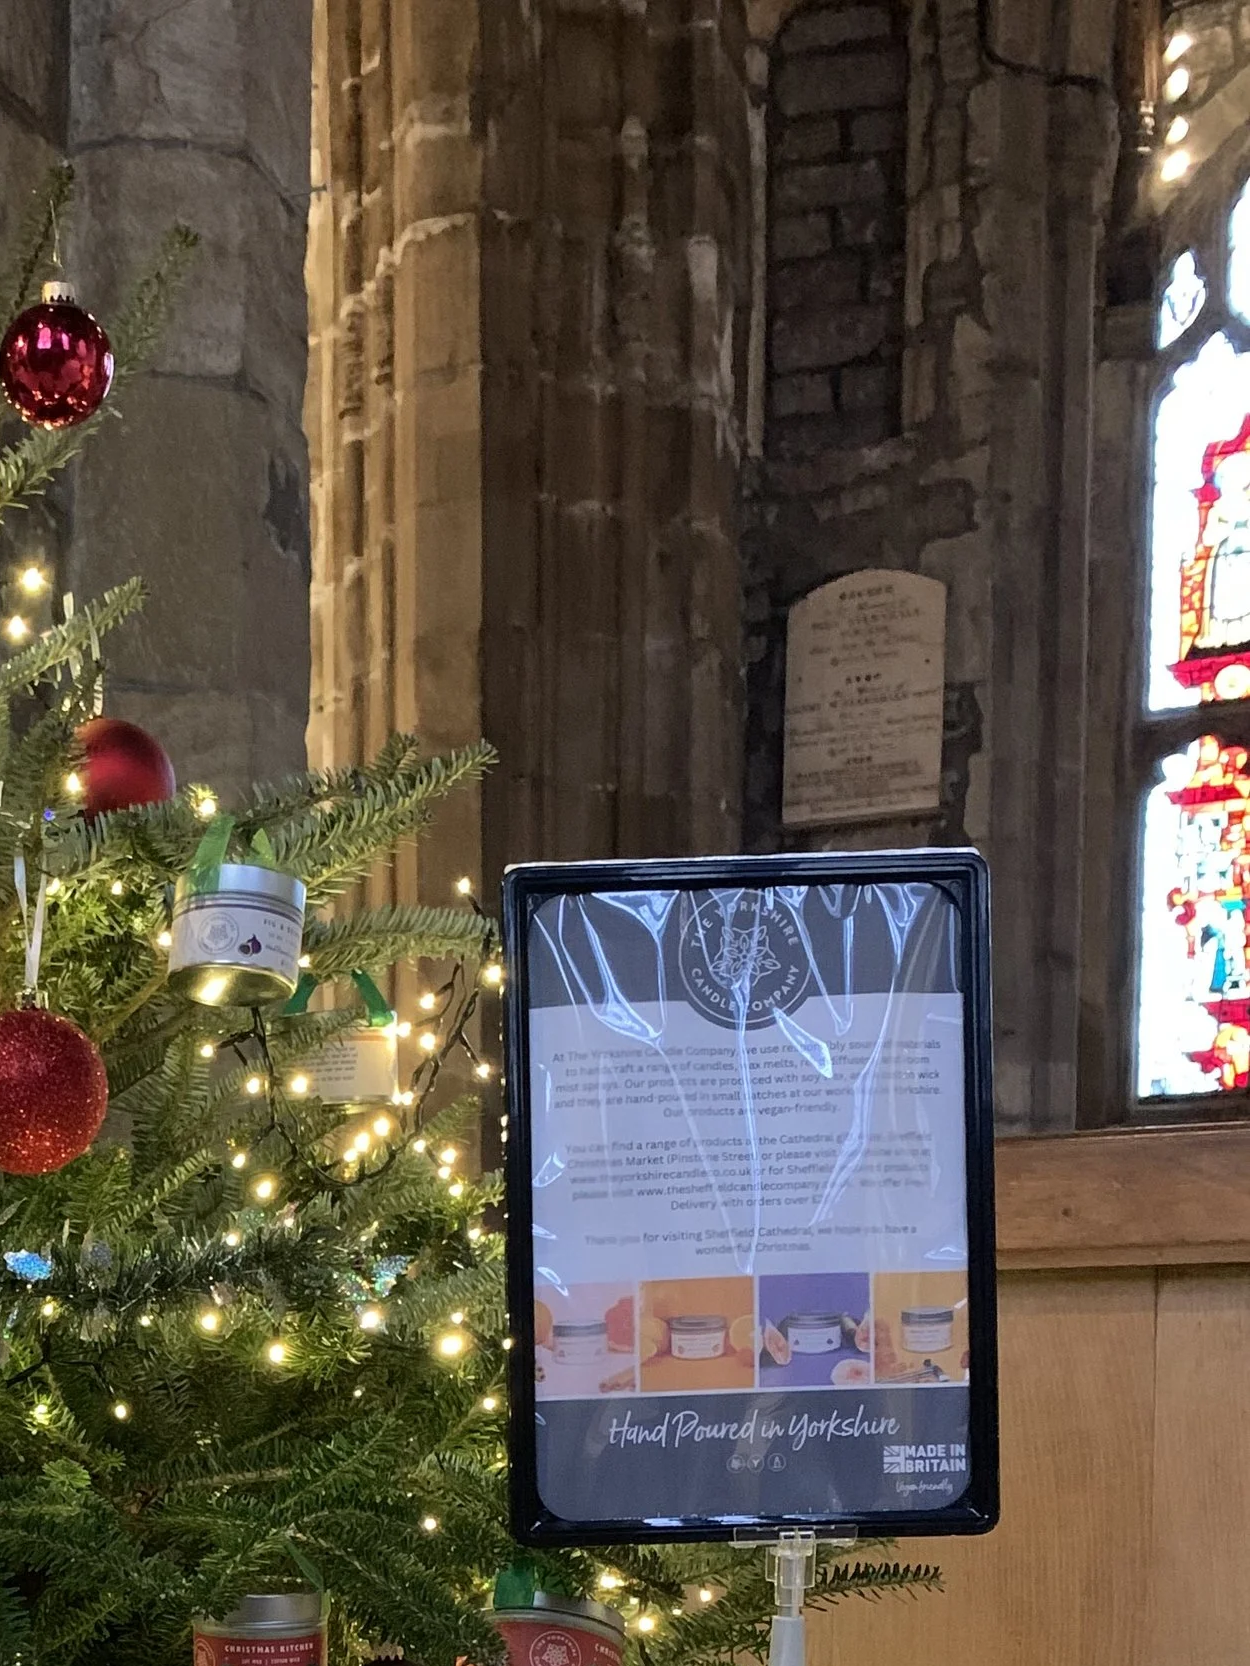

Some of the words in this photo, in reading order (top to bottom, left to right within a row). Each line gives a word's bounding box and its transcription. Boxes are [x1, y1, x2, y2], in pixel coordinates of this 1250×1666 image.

[691, 918, 713, 948] THE
[714, 900, 800, 947] YORKSHIRE
[691, 967, 737, 1012] CANDLE
[748, 965, 800, 1012] OMPANY
[552, 1053, 565, 1062] At
[645, 1047, 683, 1057] Cadle
[759, 1045, 780, 1054] use
[680, 1061, 691, 1071] of
[693, 1060, 739, 1072] candles,
[763, 1059, 798, 1070] melts,
[624, 1078, 646, 1089] Our
[648, 1077, 697, 1090] prodcts
[700, 1077, 717, 1086] are
[720, 1075, 772, 1088] prodced
[774, 1073, 798, 1083] with
[801, 1073, 820, 1085] soy
[917, 1068, 940, 1080] wick
[625, 1091, 698, 1105] hand-poued
[712, 1090, 741, 1100] small
[747, 1089, 787, 1101] atches
[789, 1089, 801, 1098] at
[803, 1088, 821, 1097] our
[611, 1140, 634, 1151] find
[645, 1140, 677, 1152] range
[679, 1136, 692, 1148] of
[758, 1136, 778, 1146] the
[779, 1133, 834, 1145] Cathedral
[625, 1155, 665, 1167] Market
[761, 1152, 773, 1161] or
[775, 1150, 812, 1162] please
[768, 1165, 784, 1175] for
[786, 1162, 835, 1175] Sheffiel
[670, 1199, 716, 1211] Delivery
[643, 1231, 660, 1243] for
[661, 1230, 703, 1242] visiting
[609, 1410, 671, 1449] Hand
[672, 1408, 759, 1449] Poured
[760, 1416, 785, 1440] in
[787, 1404, 901, 1451] Yorkshire
[904, 1444, 948, 1459] MADE
[950, 1443, 967, 1458] IN
[904, 1458, 967, 1474] BRITAIN
[224, 1644, 276, 1654] CHRISTMAS
[279, 1642, 314, 1654] KITCHEN
